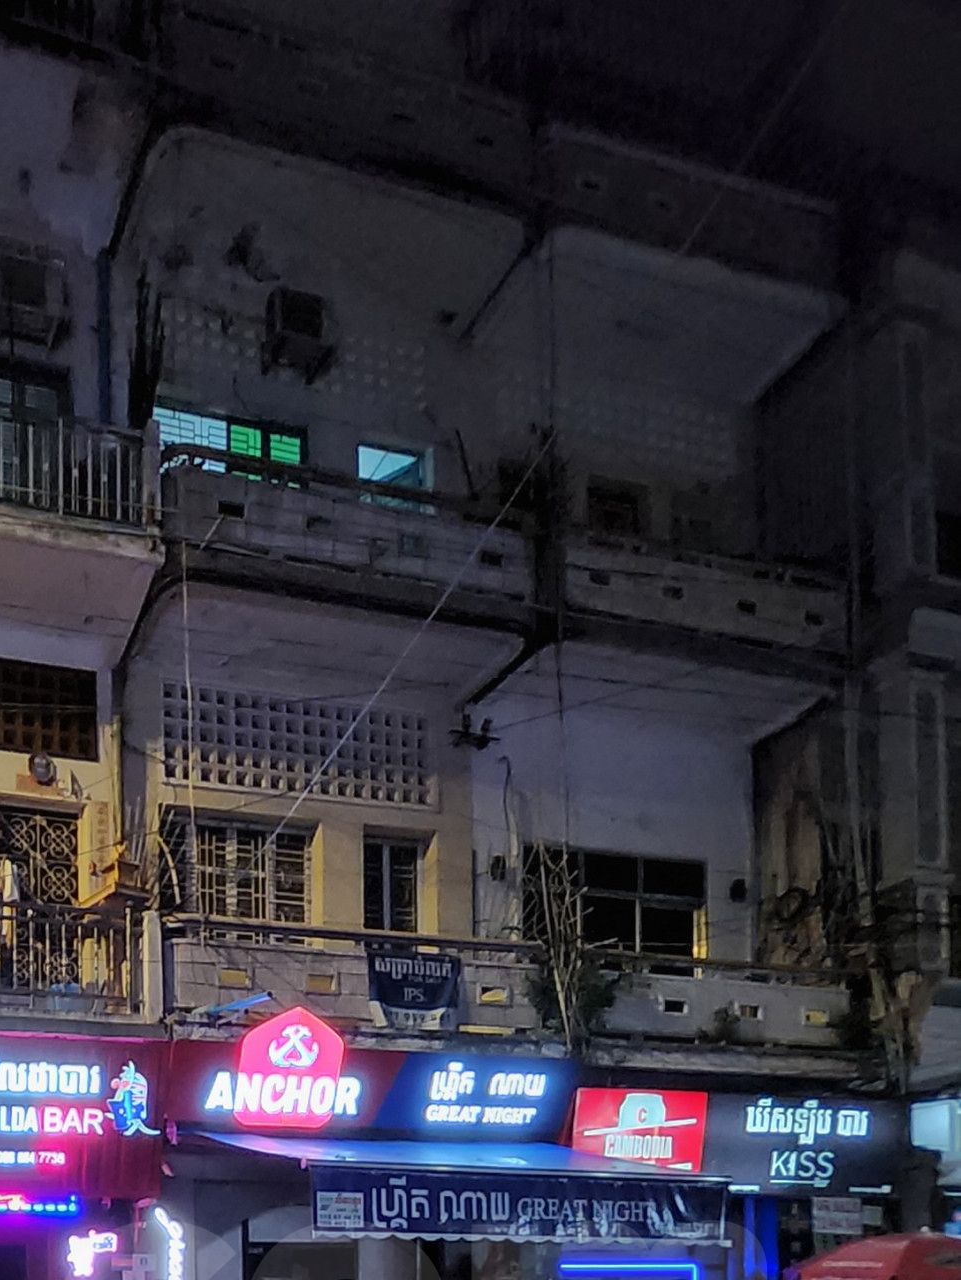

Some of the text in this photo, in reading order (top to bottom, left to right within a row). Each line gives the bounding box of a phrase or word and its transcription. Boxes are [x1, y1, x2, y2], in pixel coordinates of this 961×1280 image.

[404, 987, 424, 1002] IPS
[204, 1071, 363, 1116] ANCHOR
[42, 1106, 105, 1136] BAR
[425, 1104, 538, 1125] GREAT NIGHT
[769, 1150, 837, 1180] KISS
[517, 1198, 658, 1222] GREAT NIGHT
